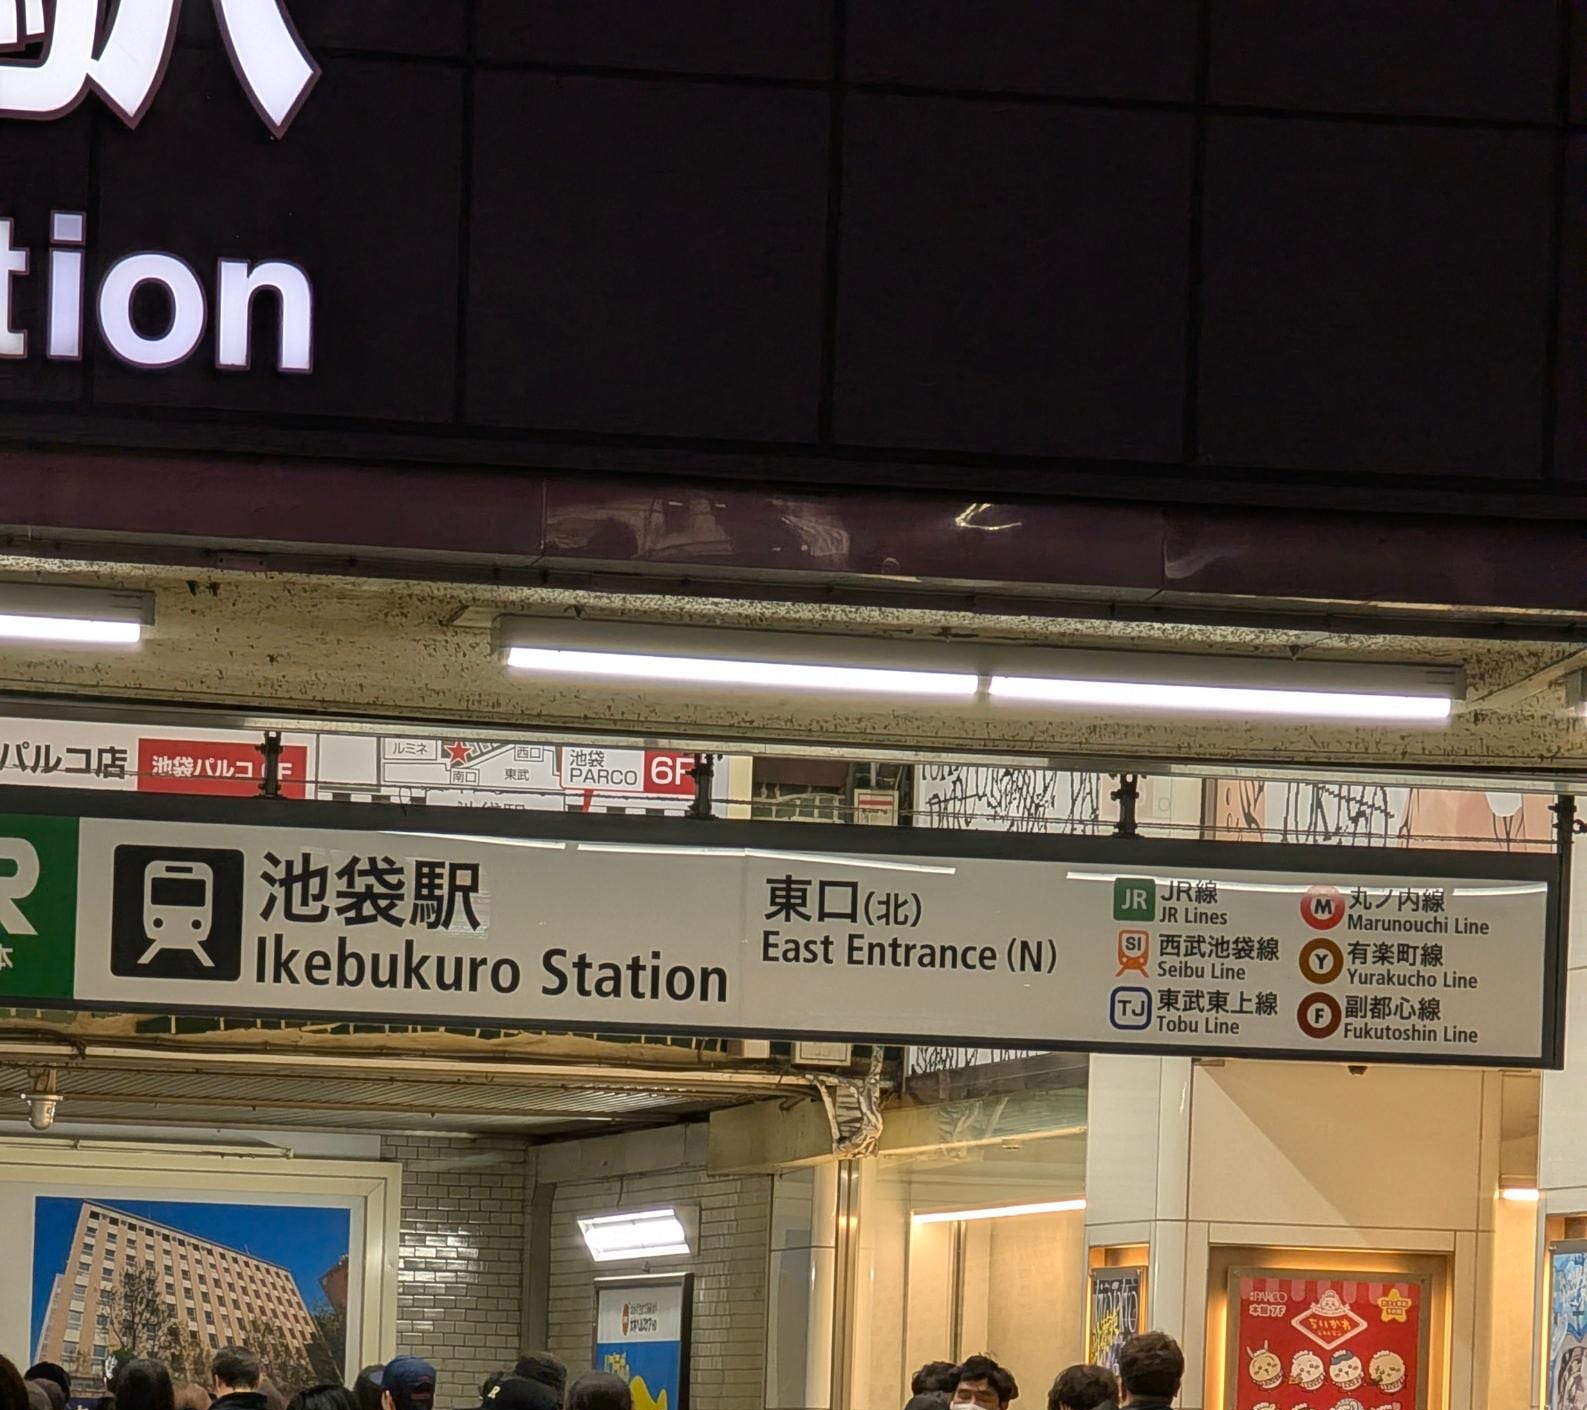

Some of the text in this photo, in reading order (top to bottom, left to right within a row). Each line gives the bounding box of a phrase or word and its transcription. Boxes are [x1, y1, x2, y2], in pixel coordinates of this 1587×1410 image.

[393, 743, 427, 755] ルミネ
[517, 747, 541, 759] 西口
[569, 749, 605, 768] 池袋
[152, 755, 253, 777] 池袋パルコ
[504, 768, 530, 781] 東武
[570, 756, 695, 785] PARCO 6F
[453, 770, 477, 783] 南口
[259, 850, 481, 932] 池袋駅
[1121, 888, 1147, 910] JR
[1160, 880, 1218, 904] JR線
[1349, 886, 1444, 913] 丸ノ内線
[1159, 906, 1228, 925] JR Lines
[1314, 899, 1332, 915] M
[1347, 914, 1489, 935] Marunouchi Line
[762, 930, 1057, 974] East Entrance (N)
[1125, 937, 1142, 951] SI
[1159, 933, 1279, 961] 西武池袋線
[1347, 940, 1443, 967] 有楽町線
[256, 933, 728, 1003] Ikebukuro Station
[1157, 961, 1246, 980] Seibu Line
[1314, 954, 1328, 970] Y
[1347, 969, 1478, 989] Yurakucho Line
[1118, 1000, 1145, 1017] TJ
[1157, 988, 1278, 1016] 東武東上線
[1344, 995, 1441, 1022] 副都心線
[1156, 1015, 1240, 1034] Tobu Line
[1314, 1008, 1325, 1024] F
[1343, 1023, 1478, 1043] Fukutoshin Line
